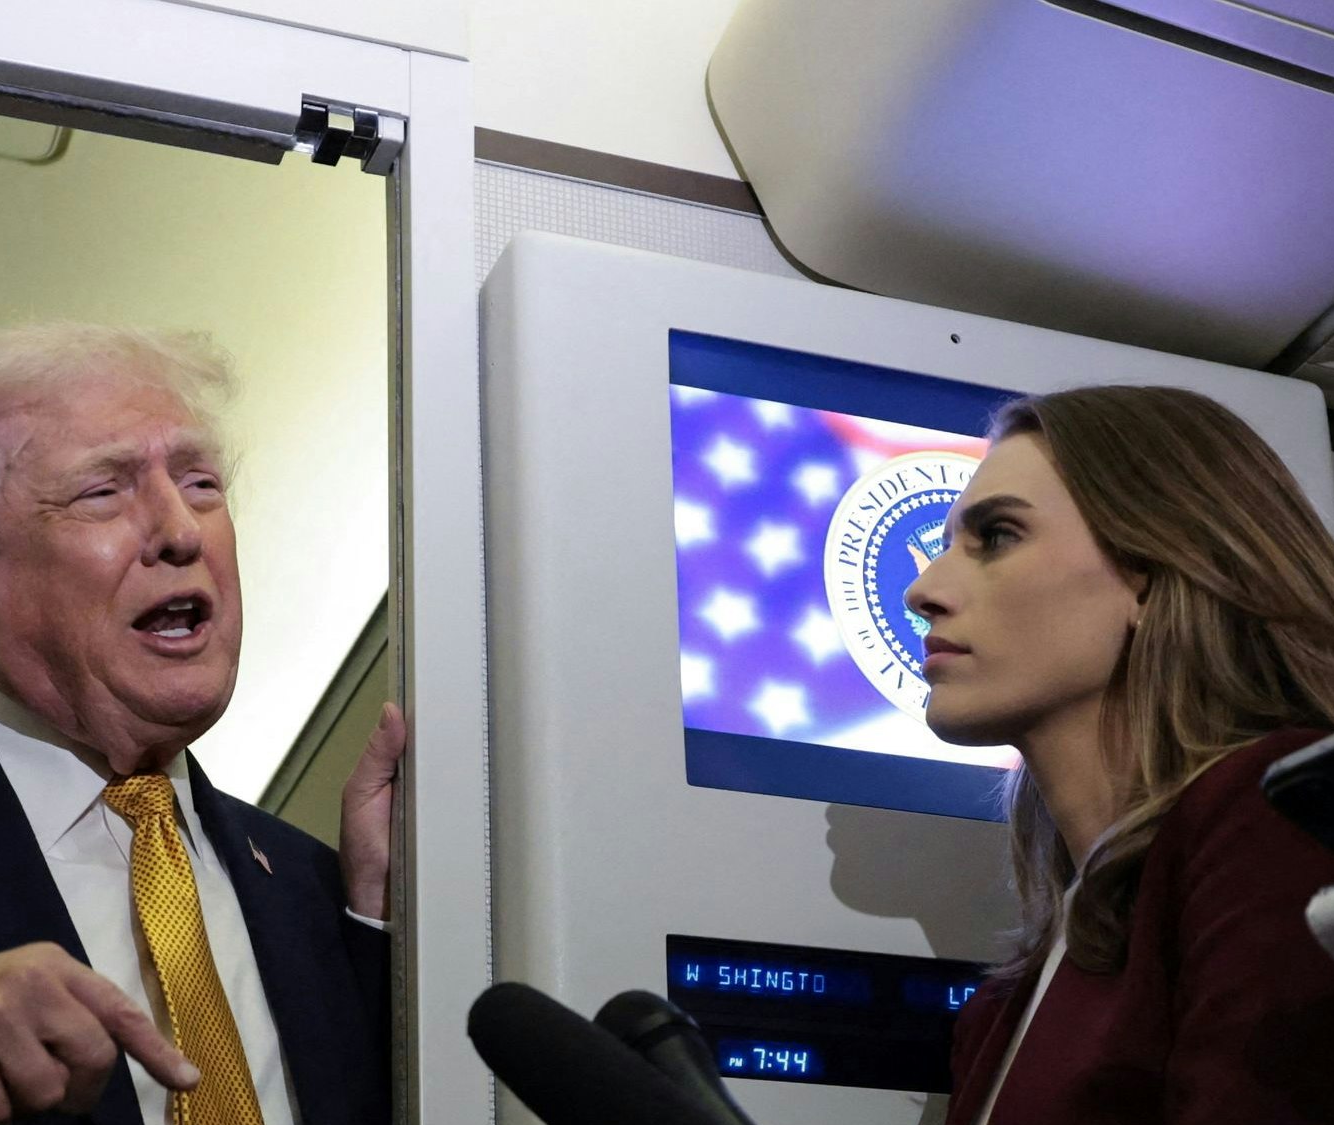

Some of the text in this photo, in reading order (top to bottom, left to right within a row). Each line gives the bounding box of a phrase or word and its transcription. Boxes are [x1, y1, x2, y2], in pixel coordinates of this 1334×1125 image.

[838, 464, 952, 569] PRESIDENT
[729, 1047, 807, 1073] PM 7:44
